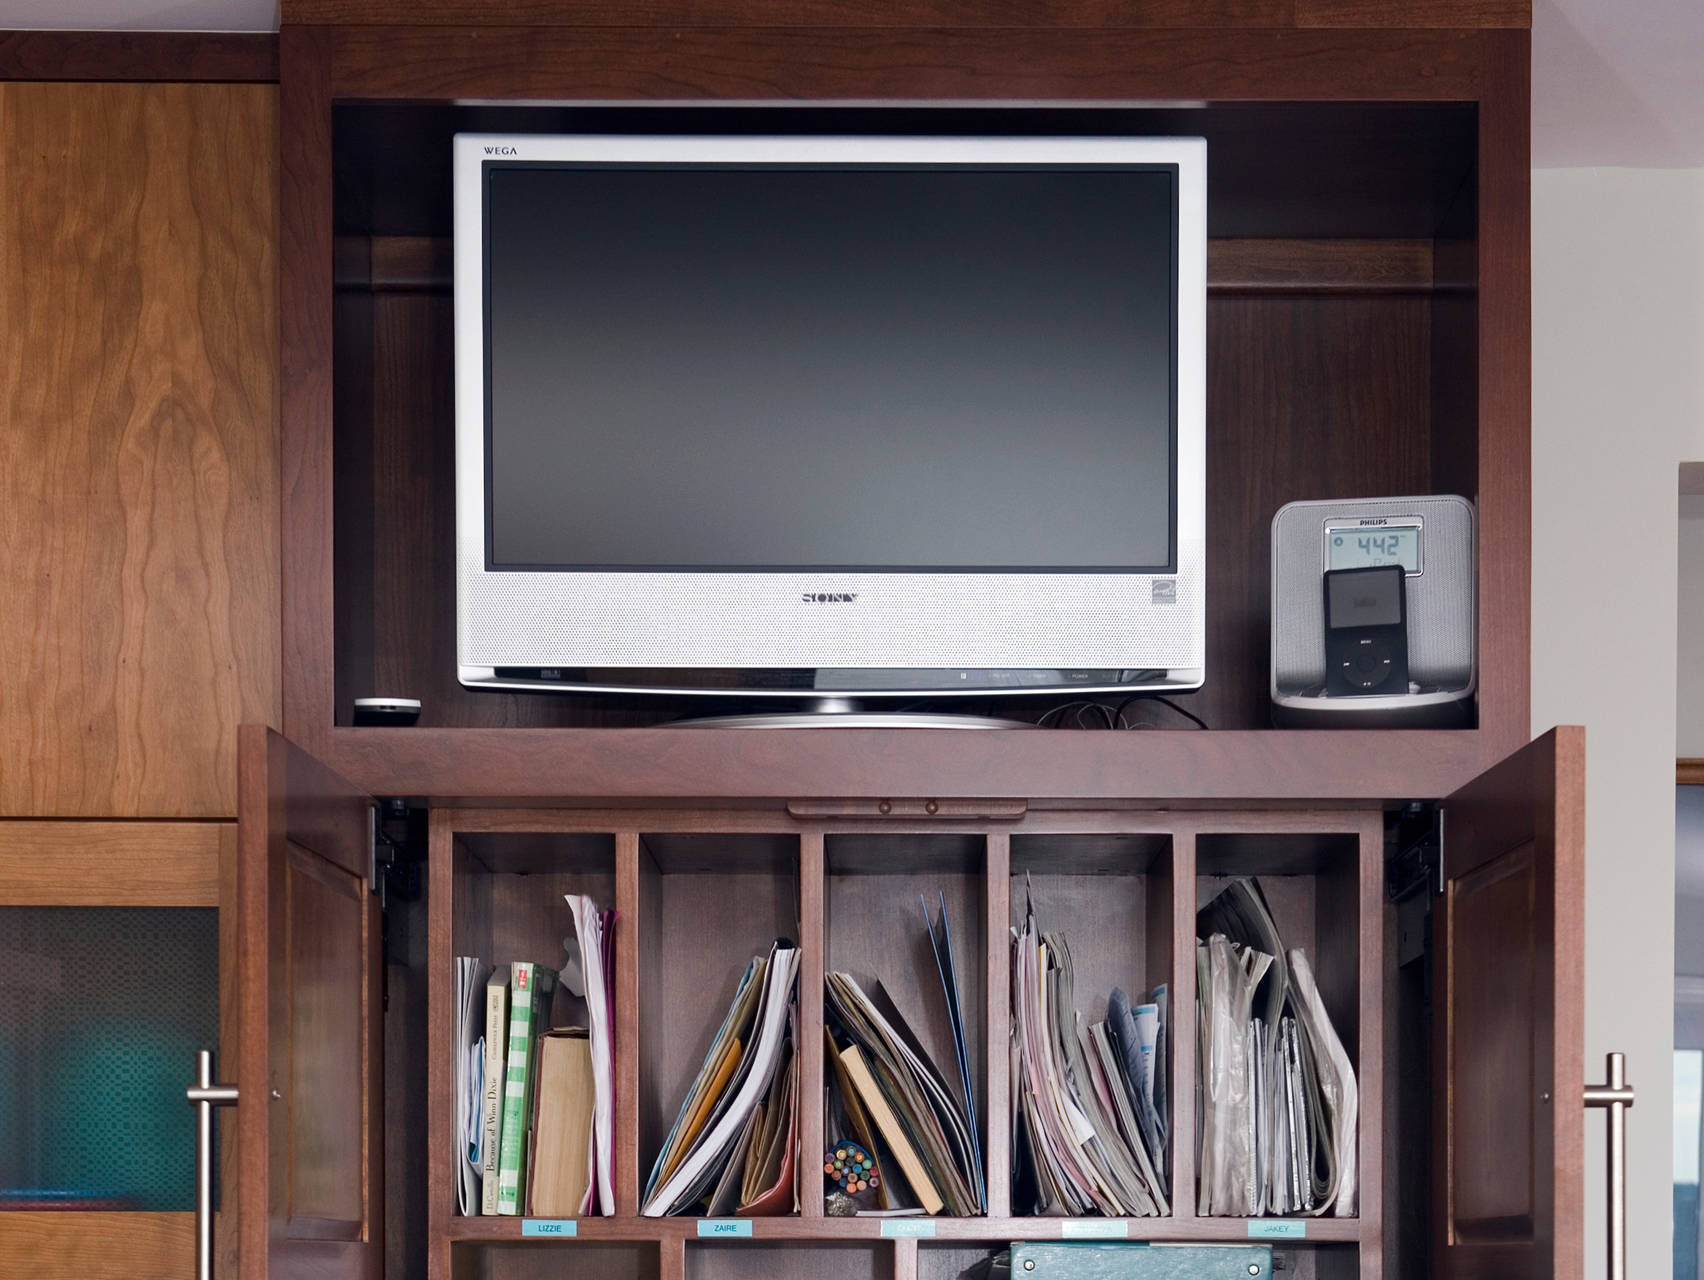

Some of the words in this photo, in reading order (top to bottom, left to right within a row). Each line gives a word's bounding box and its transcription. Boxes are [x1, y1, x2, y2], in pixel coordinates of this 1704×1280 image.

[484, 146, 518, 156] WEGA
[1359, 518, 1388, 526] PHILIPS
[486, 1127, 496, 1137] of
[485, 1138, 497, 1172] Because
[537, 1224, 562, 1233] LIZZIE
[713, 1224, 737, 1232] ZAIRE
[1263, 1225, 1289, 1233] JAKEY
